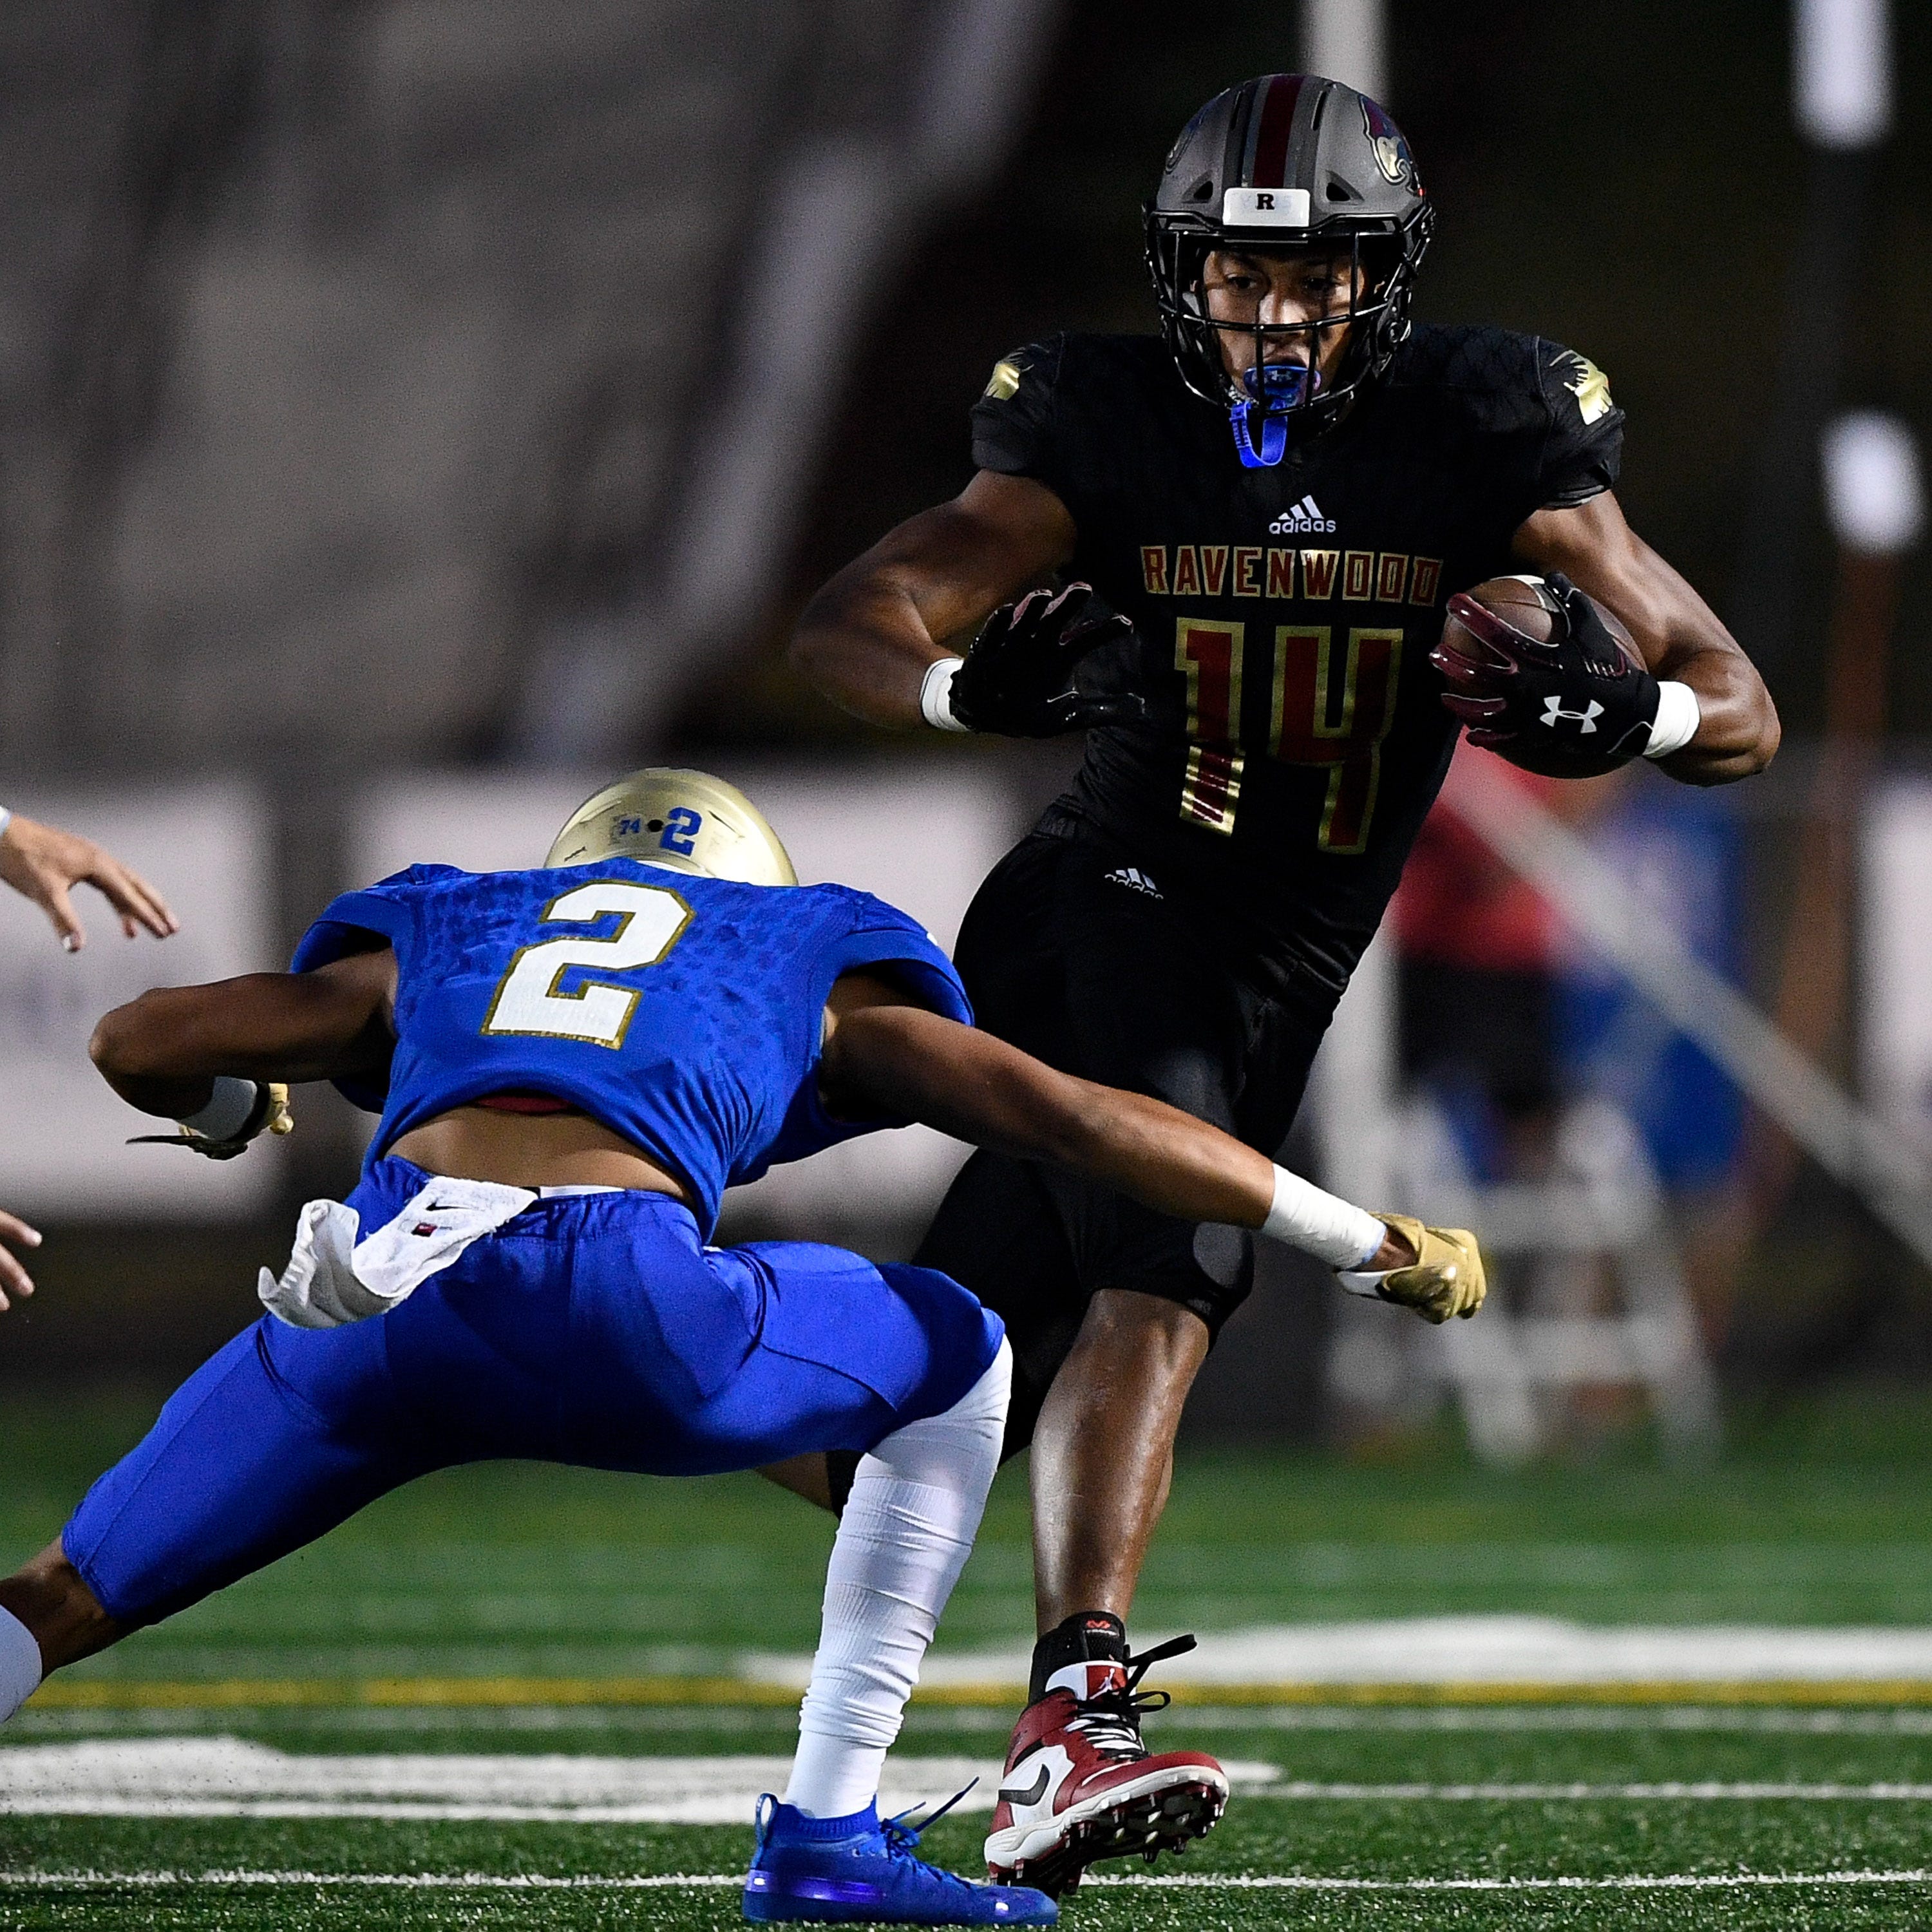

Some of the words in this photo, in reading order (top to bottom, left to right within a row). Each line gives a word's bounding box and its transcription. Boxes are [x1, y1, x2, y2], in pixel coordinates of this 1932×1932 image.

[1256, 193, 1275, 211] R
[1269, 517, 1336, 535] adidas
[1140, 545, 1444, 607] RAVENWOOD
[1174, 617, 1404, 855] 14
[659, 806, 702, 857] 2
[480, 878, 697, 1051] 2
